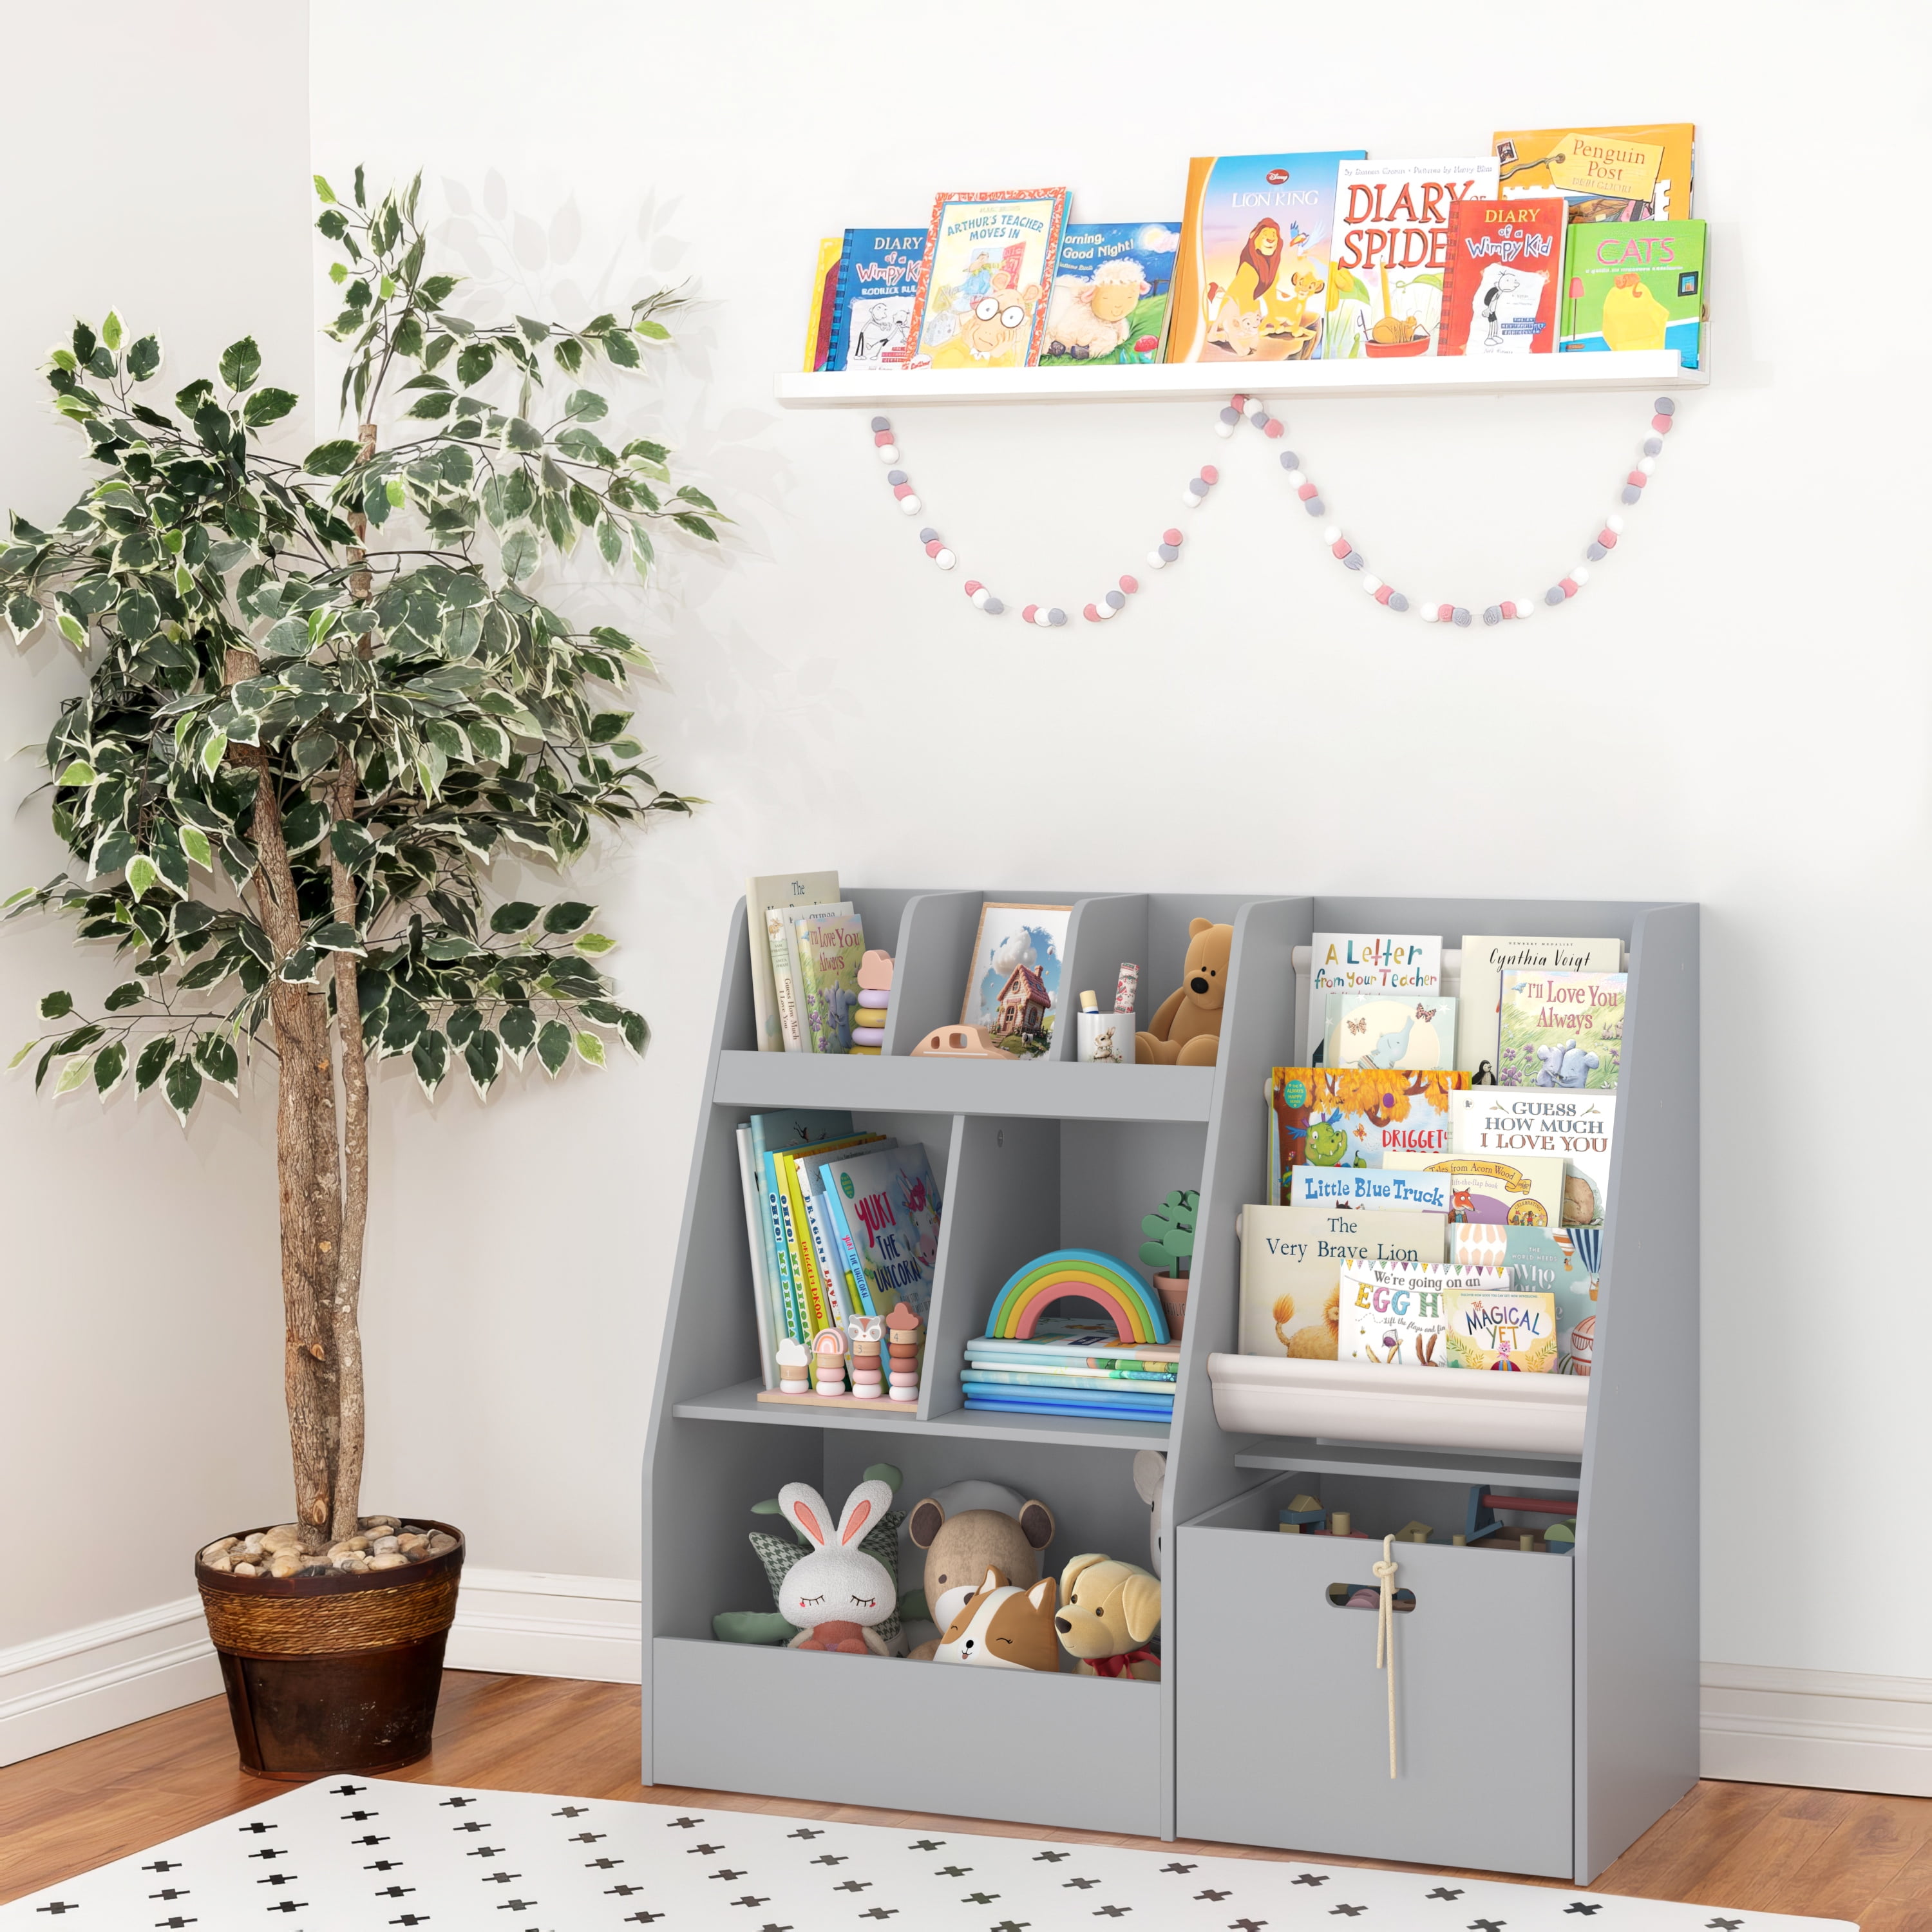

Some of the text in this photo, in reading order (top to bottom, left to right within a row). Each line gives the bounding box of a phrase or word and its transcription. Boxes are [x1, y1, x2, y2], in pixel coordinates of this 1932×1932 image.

[1573, 138, 1645, 165] Penguin
[1587, 160, 1624, 181] Post
[1231, 189, 1319, 207] LION KING
[1343, 180, 1475, 225] DIARY
[947, 214, 1044, 236] ARTHUR'S TEACHER
[1484, 208, 1541, 223] DIARY
[874, 236, 923, 250] DIARY
[969, 227, 1020, 242] MOVES IN
[1498, 224, 1524, 238] of a
[884, 251, 898, 265] of
[1063, 247, 1094, 259] Good
[1338, 228, 1449, 270] SPIDE
[1464, 233, 1553, 262] Wimpy Kid
[1596, 237, 1676, 266] CATS
[855, 262, 906, 286] Wimpy
[791, 880, 805, 896] The
[810, 927, 860, 948] I'll Love You
[819, 951, 845, 976] Always
[1325, 938, 1423, 967] A Letter
[1489, 948, 1591, 973] Cynthia Voigt
[1314, 968, 1345, 989] from
[1378, 967, 1437, 988] Teacher
[1527, 980, 1618, 1007] I'll Love You
[790, 1020, 800, 1040] Much
[1536, 1006, 1593, 1035] Always
[1512, 1101, 1577, 1117] GUESS
[1485, 1117, 1604, 1135] HOW MUCH
[1481, 1133, 1609, 1153] I LOVE YOU
[1451, 1163, 1468, 1172] from
[1471, 1162, 1493, 1174] Acorn
[1495, 1165, 1516, 1180] Wood
[1305, 1177, 1446, 1208] Little Blue Truck
[1484, 1180, 1499, 1189] book
[1514, 1200, 1542, 1211] CELEBRATING
[854, 1191, 896, 1248] YUKI
[1327, 1217, 1358, 1233] The
[804, 1195, 838, 1309] DRAGONS LOVE
[875, 1234, 901, 1261] THE
[1266, 1238, 1419, 1263] Very Brave Lion
[778, 1251, 789, 1276] MY
[790, 1252, 801, 1277] MY
[841, 1235, 869, 1298] YUKI THE UNICORN
[873, 1256, 922, 1293] UNICORN
[1374, 1270, 1481, 1292] We're going on an
[1513, 1263, 1555, 1290] Who
[782, 1280, 796, 1338] DINOSA
[1354, 1282, 1444, 1318] EGG H
[1471, 1300, 1484, 1312] THE
[1383, 1317, 1396, 1327] Lift
[1406, 1320, 1423, 1333] flaps
[1437, 1324, 1446, 1334] fin
[1464, 1306, 1540, 1336] MAGICAL
[857, 1344, 863, 1354] 3
[893, 1332, 899, 1342] 4
[1486, 1325, 1519, 1350] YET
